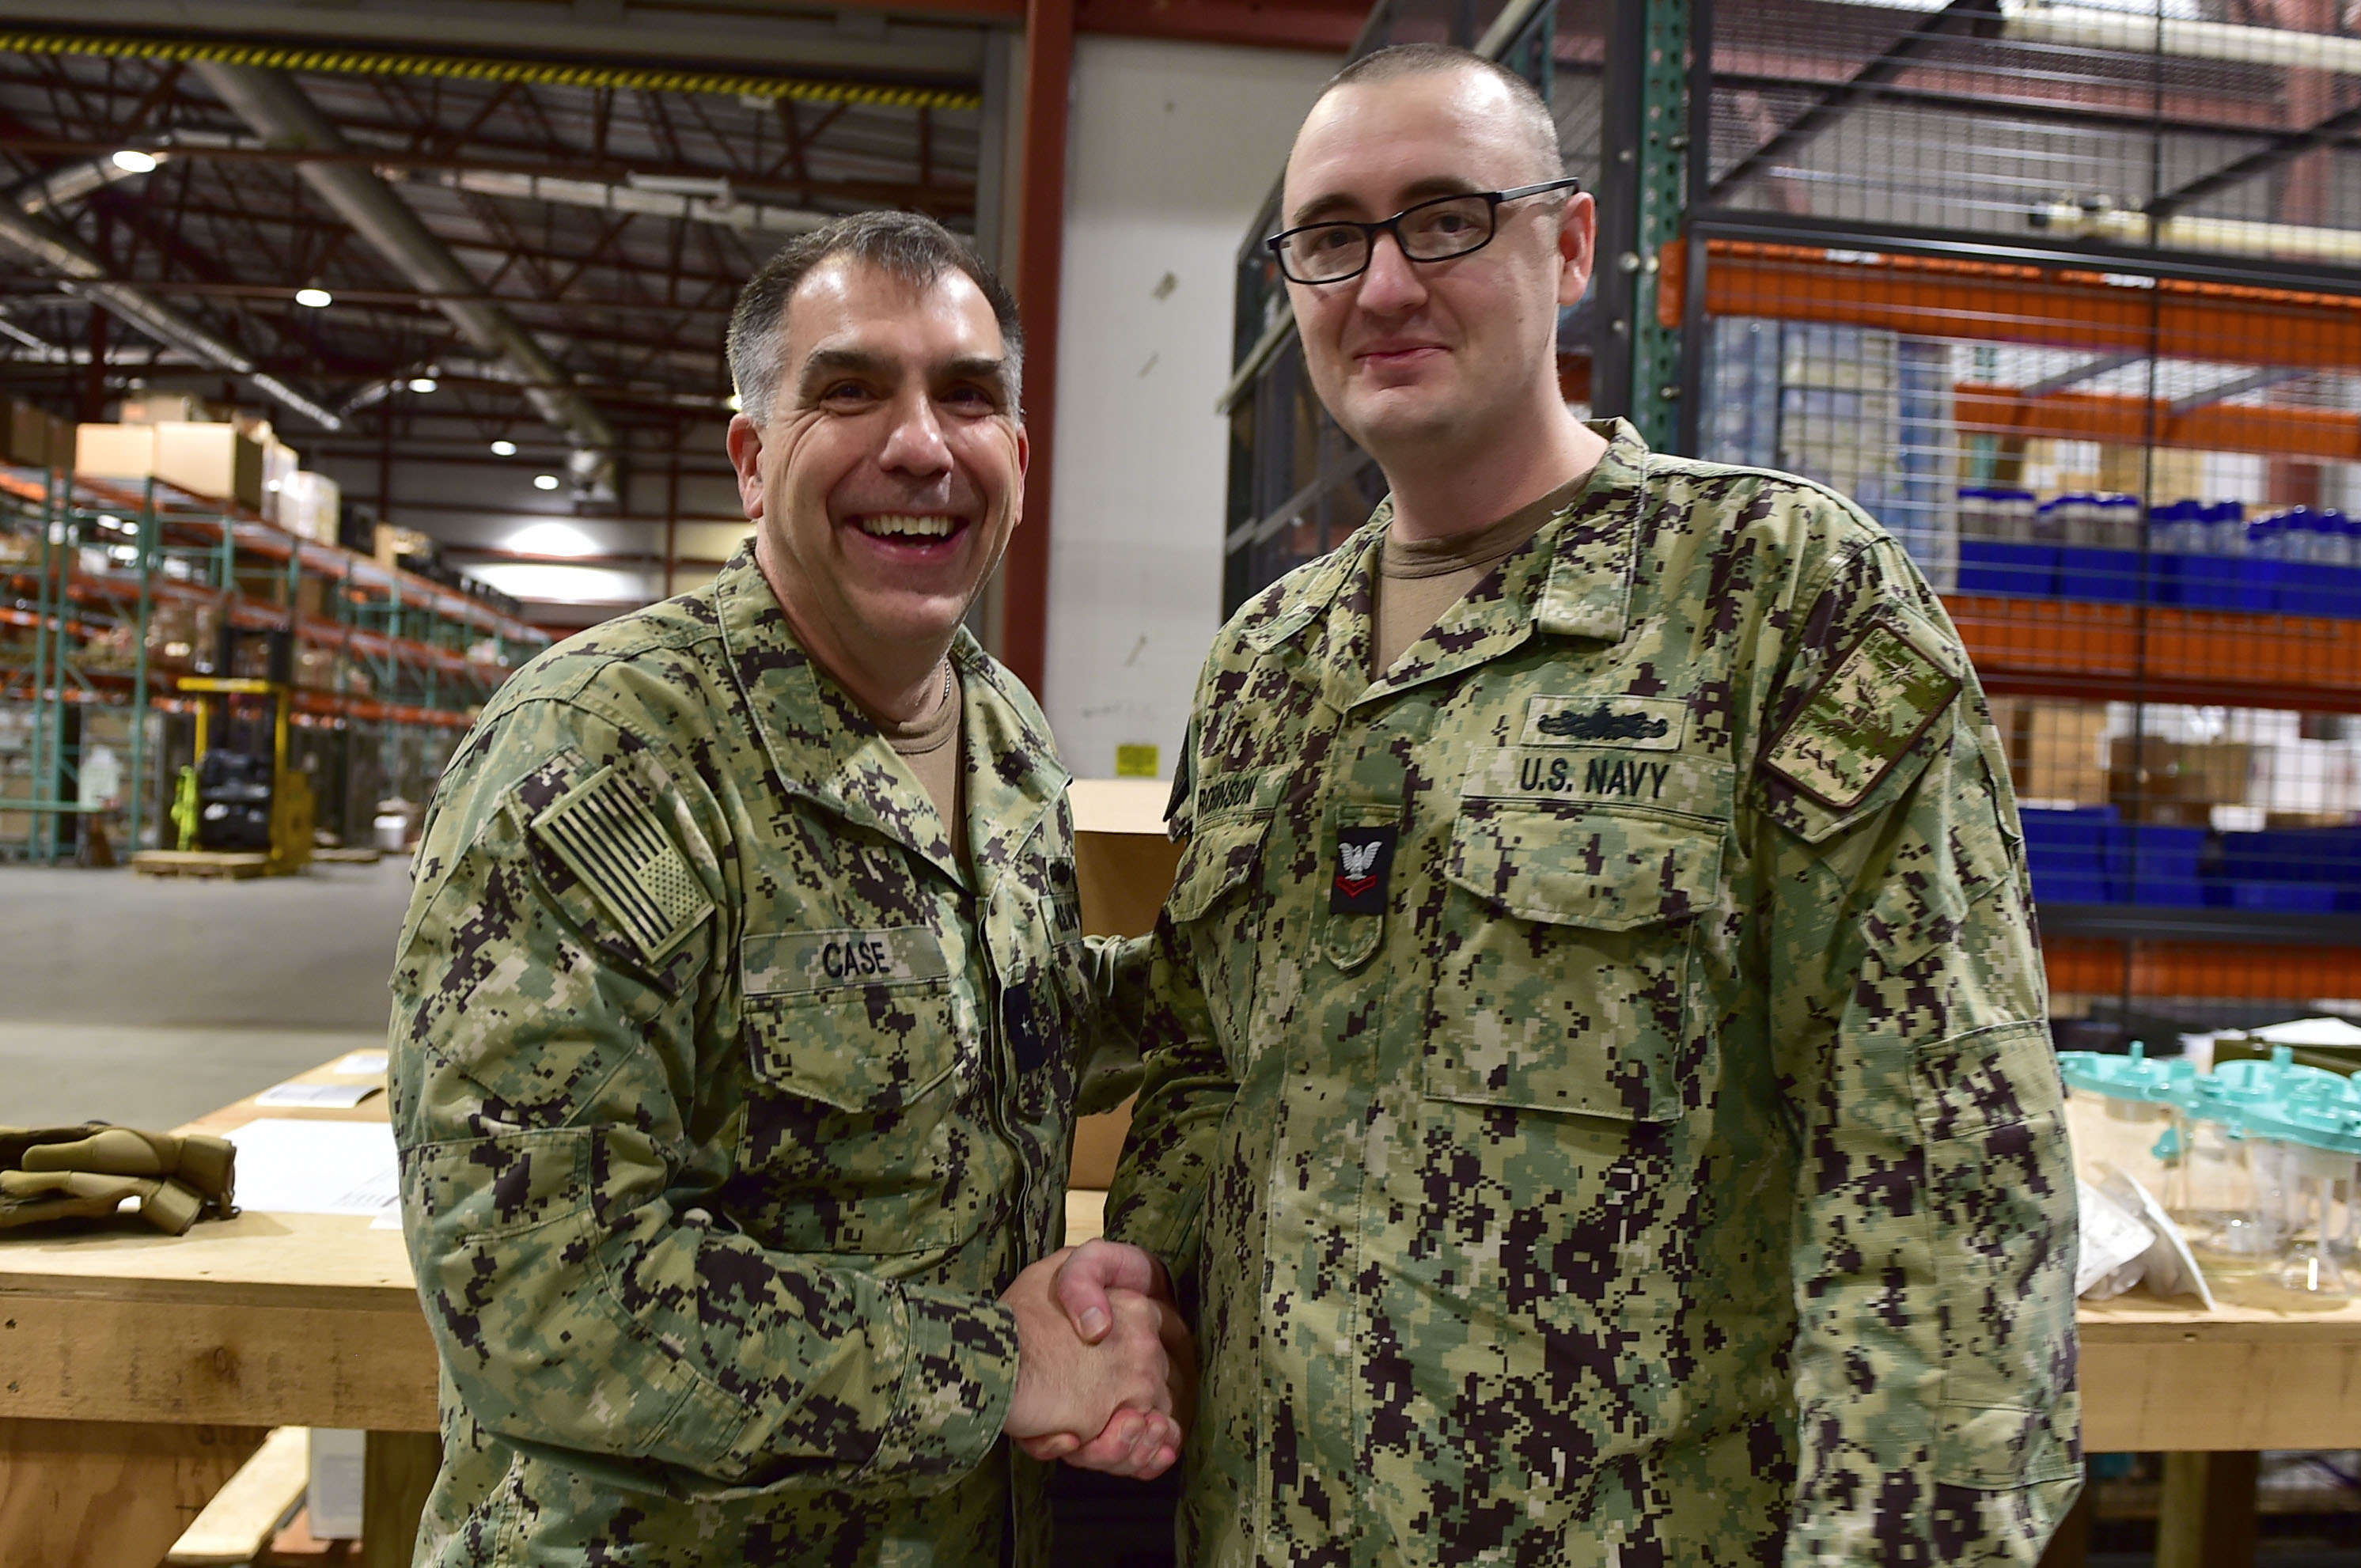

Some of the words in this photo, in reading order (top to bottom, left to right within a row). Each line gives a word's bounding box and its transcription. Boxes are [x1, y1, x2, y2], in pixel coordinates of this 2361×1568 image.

[1520, 757, 1573, 793] U.S.
[1584, 758, 1670, 799] NAVY
[822, 941, 891, 979] CASE
